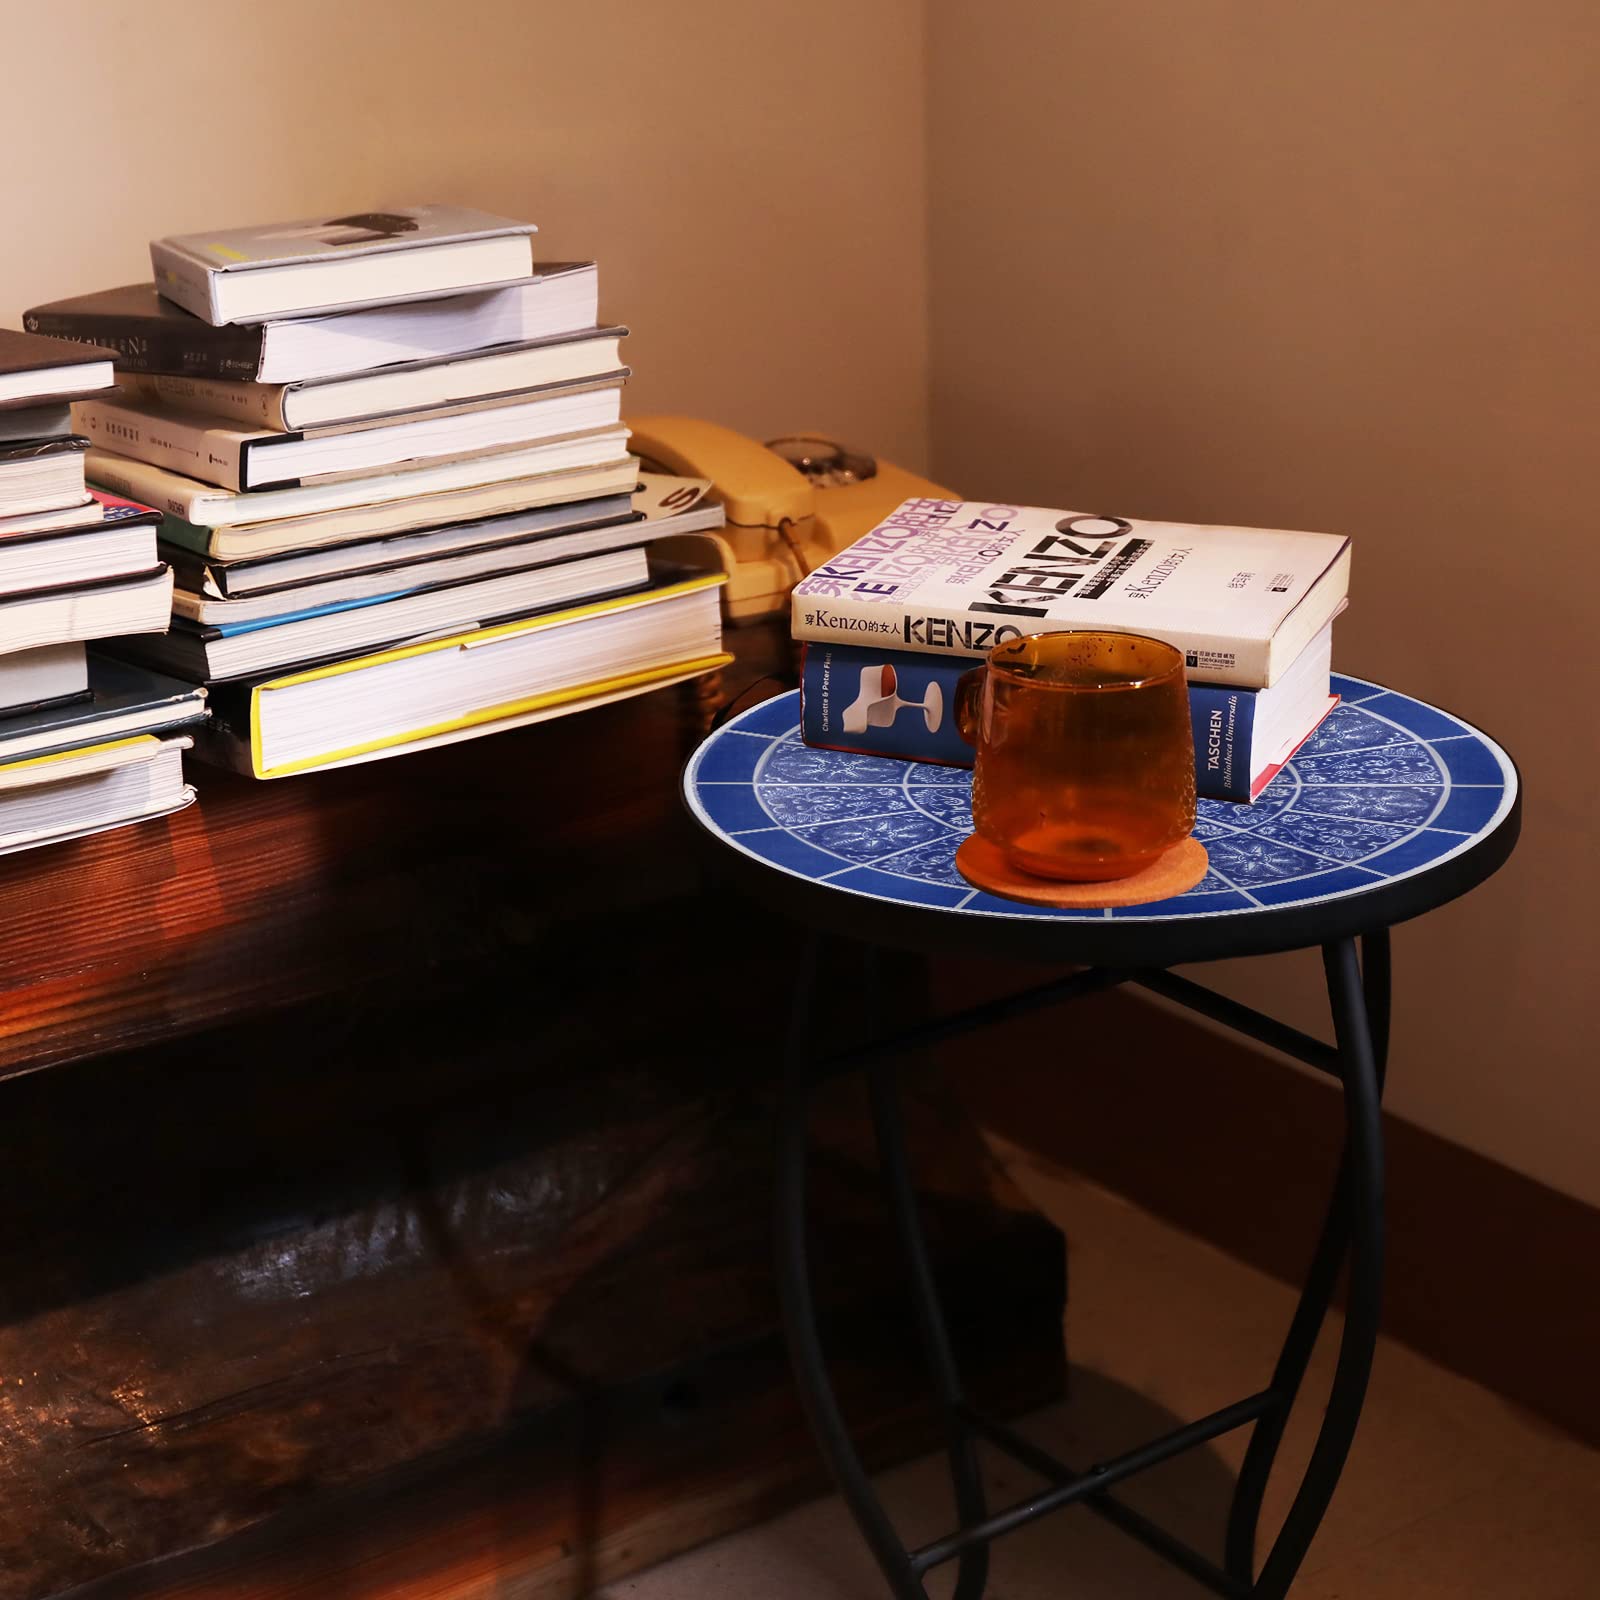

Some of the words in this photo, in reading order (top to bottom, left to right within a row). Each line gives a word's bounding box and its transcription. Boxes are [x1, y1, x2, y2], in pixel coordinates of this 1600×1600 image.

[968, 514, 1134, 618] KENZO
[804, 609, 901, 635] 穿Kenzo的女人
[821, 670, 831, 691] Peter
[821, 698, 830, 732] Charlotte
[1225, 695, 1238, 742] Universalis
[1208, 710, 1222, 771] TASCHEN
[1223, 743, 1233, 789] Bibliotheca
